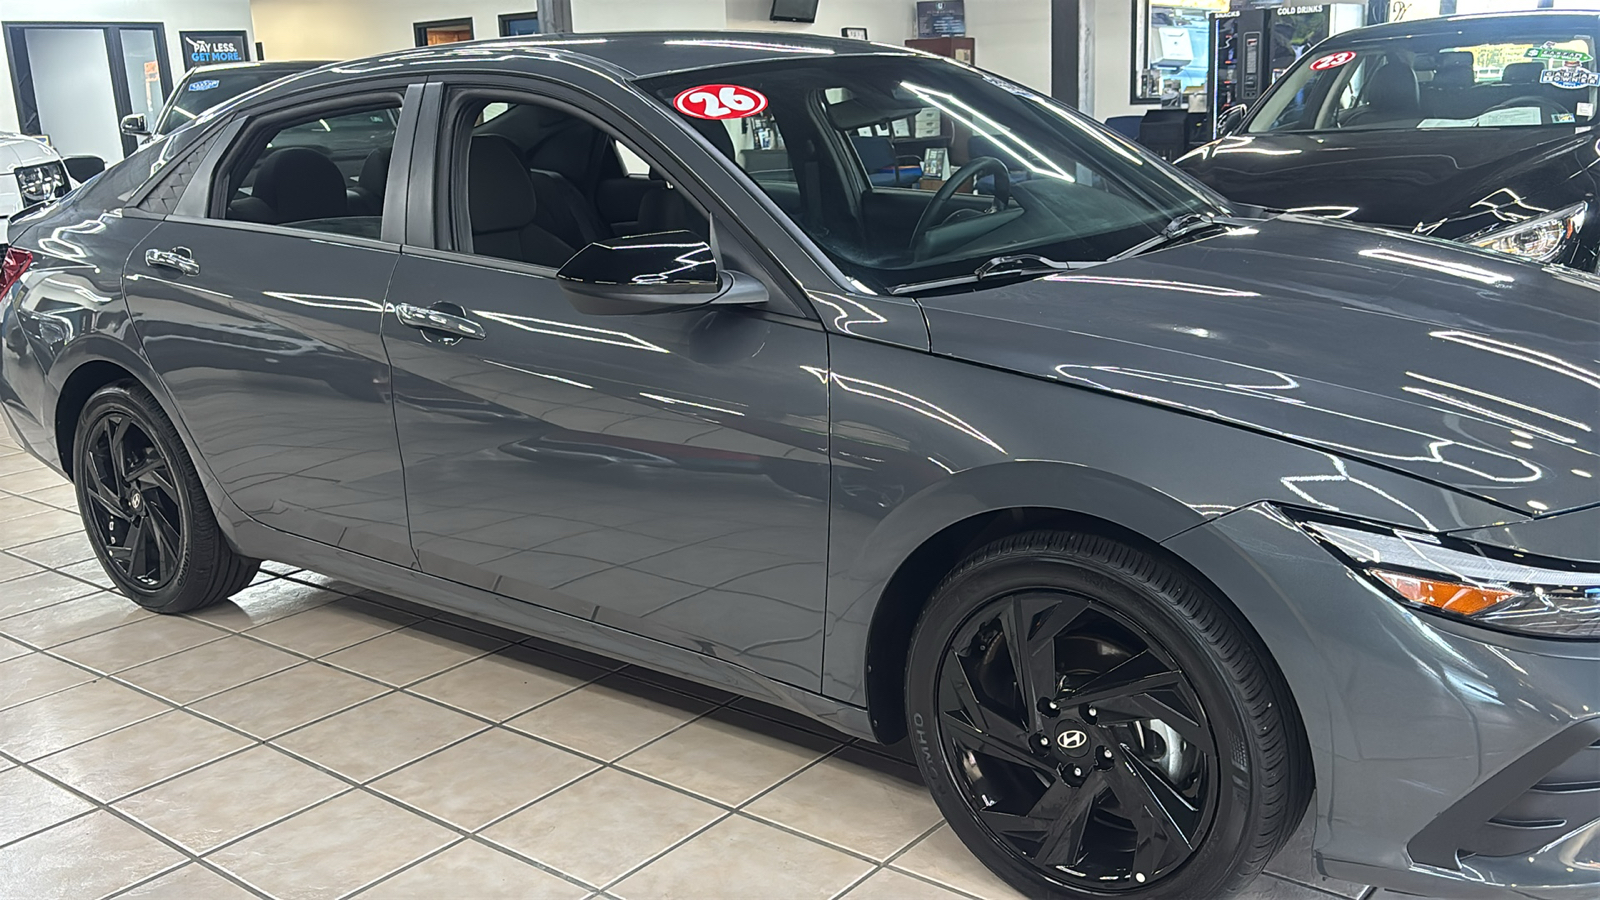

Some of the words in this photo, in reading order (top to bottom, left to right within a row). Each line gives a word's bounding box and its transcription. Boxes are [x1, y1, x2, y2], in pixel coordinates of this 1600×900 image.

[1277, 6, 1296, 16] COLD
[1297, 4, 1323, 14] DRINKS
[194, 42, 211, 53] PAY
[212, 42, 237, 53] LESS.
[191, 52, 210, 62] GET
[211, 52, 242, 62] MORE.
[1316, 52, 1349, 69] 23
[1544, 70, 1598, 80] CARFAX
[688, 87, 756, 117] 26
